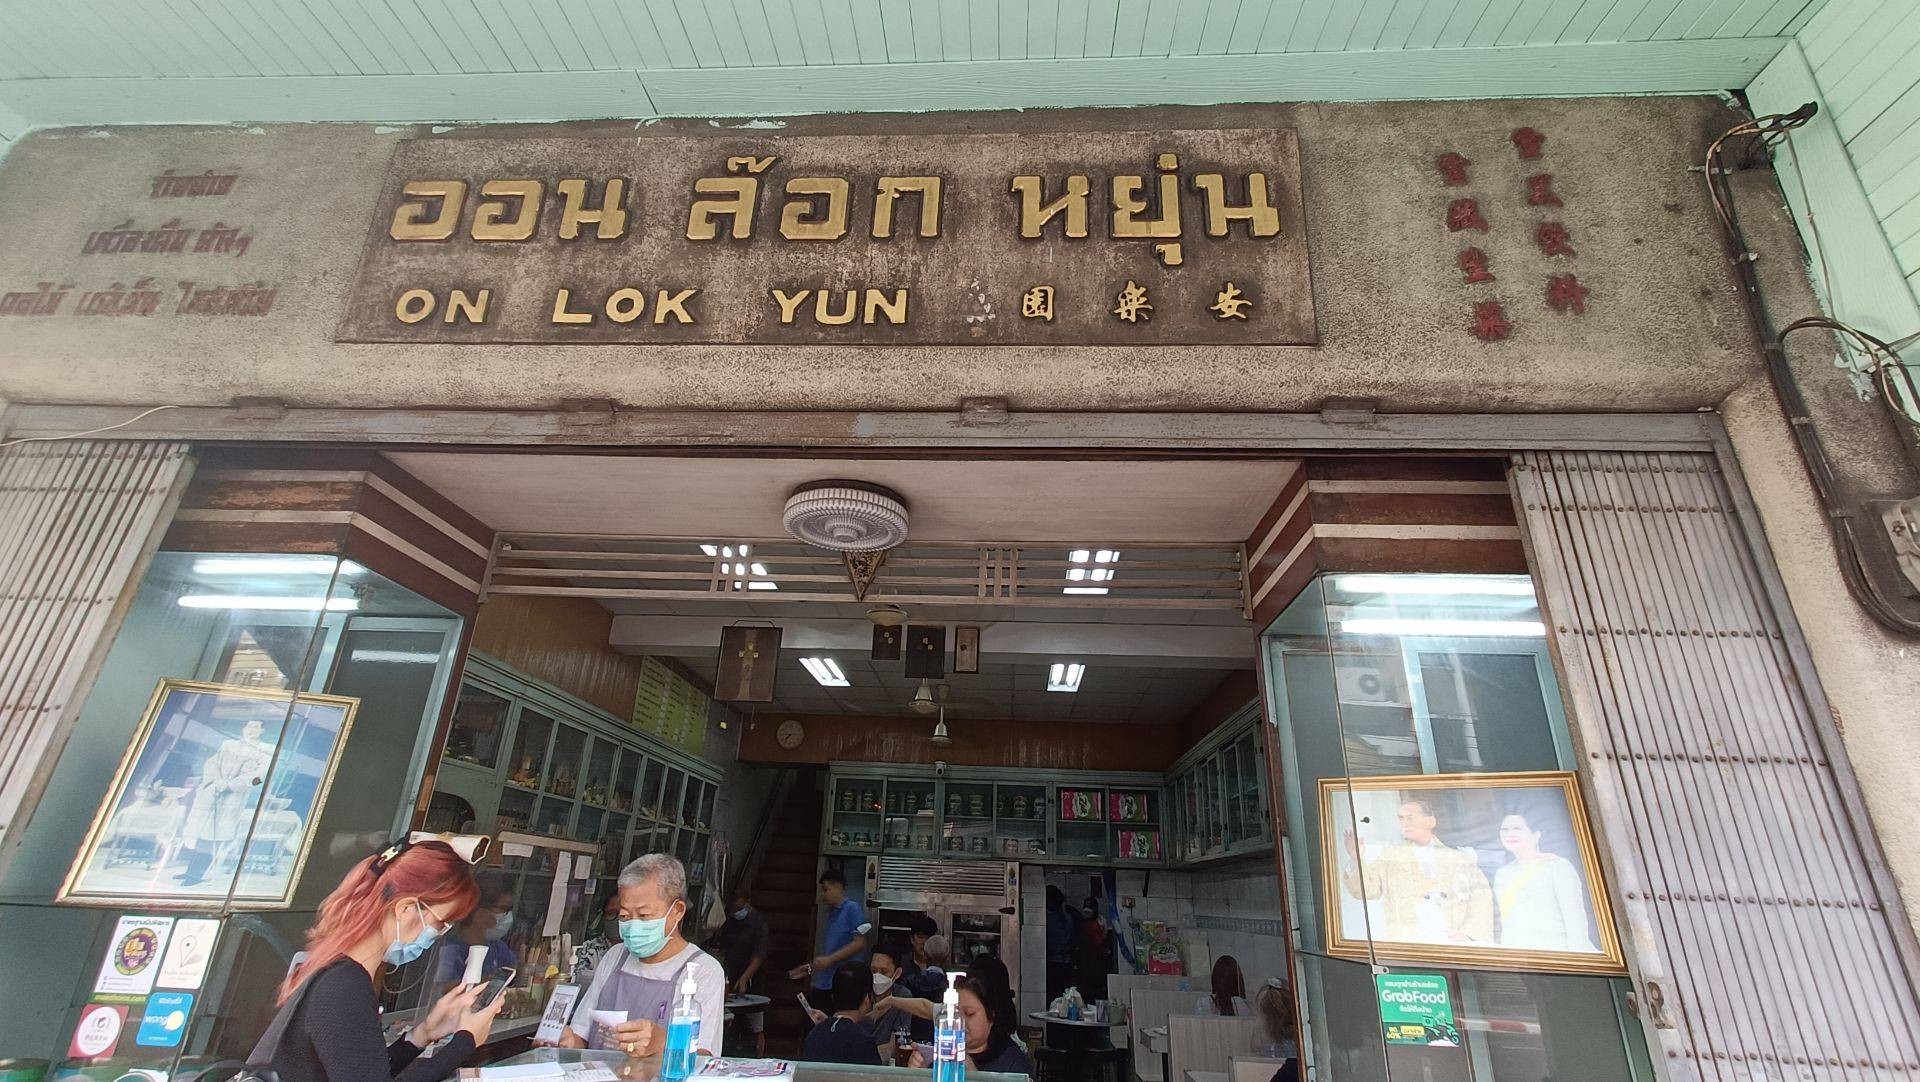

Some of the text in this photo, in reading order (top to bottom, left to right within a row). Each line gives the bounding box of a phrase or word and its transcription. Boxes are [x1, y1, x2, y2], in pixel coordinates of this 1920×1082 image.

[390, 177, 627, 240] ออน
[1011, 153, 1281, 266] หยุ่น
[394, 287, 908, 325] ON LOK YUN
[1382, 989, 1446, 1004] GrabFood
